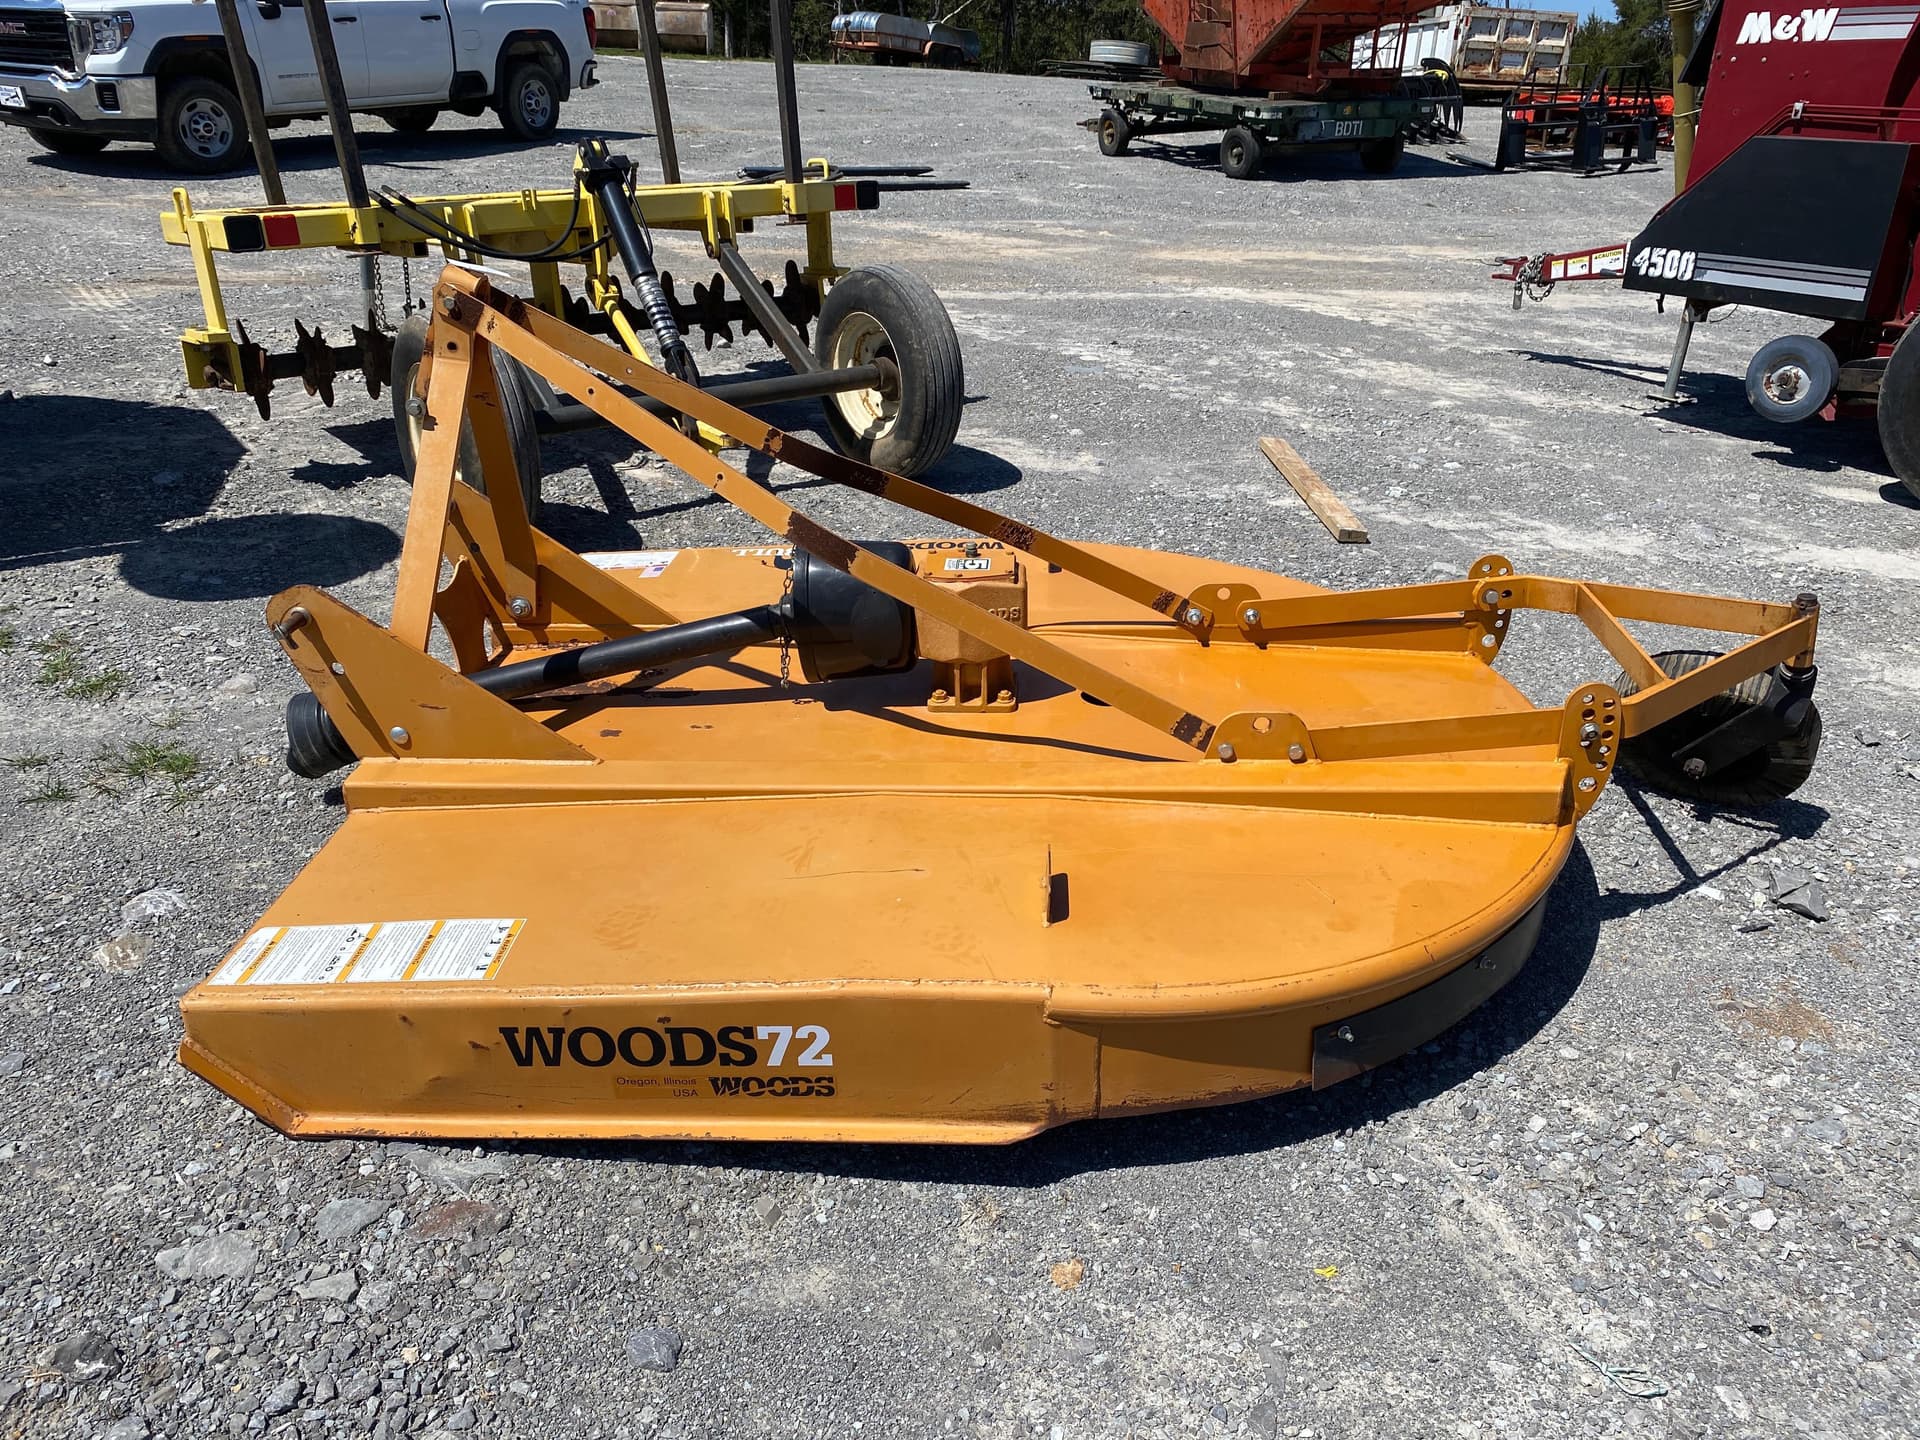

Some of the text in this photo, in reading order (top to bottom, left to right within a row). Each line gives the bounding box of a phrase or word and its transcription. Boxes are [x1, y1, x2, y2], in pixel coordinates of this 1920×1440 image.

[0, 22, 25, 34] MC
[1735, 7, 1840, 45] M&W
[1597, 250, 1622, 259] CAUTION
[1632, 247, 1696, 281] 4500
[616, 1076, 698, 1088] Oregon, Illinois
[709, 1076, 836, 1098] WOODS
[672, 1088, 699, 1098] USA
